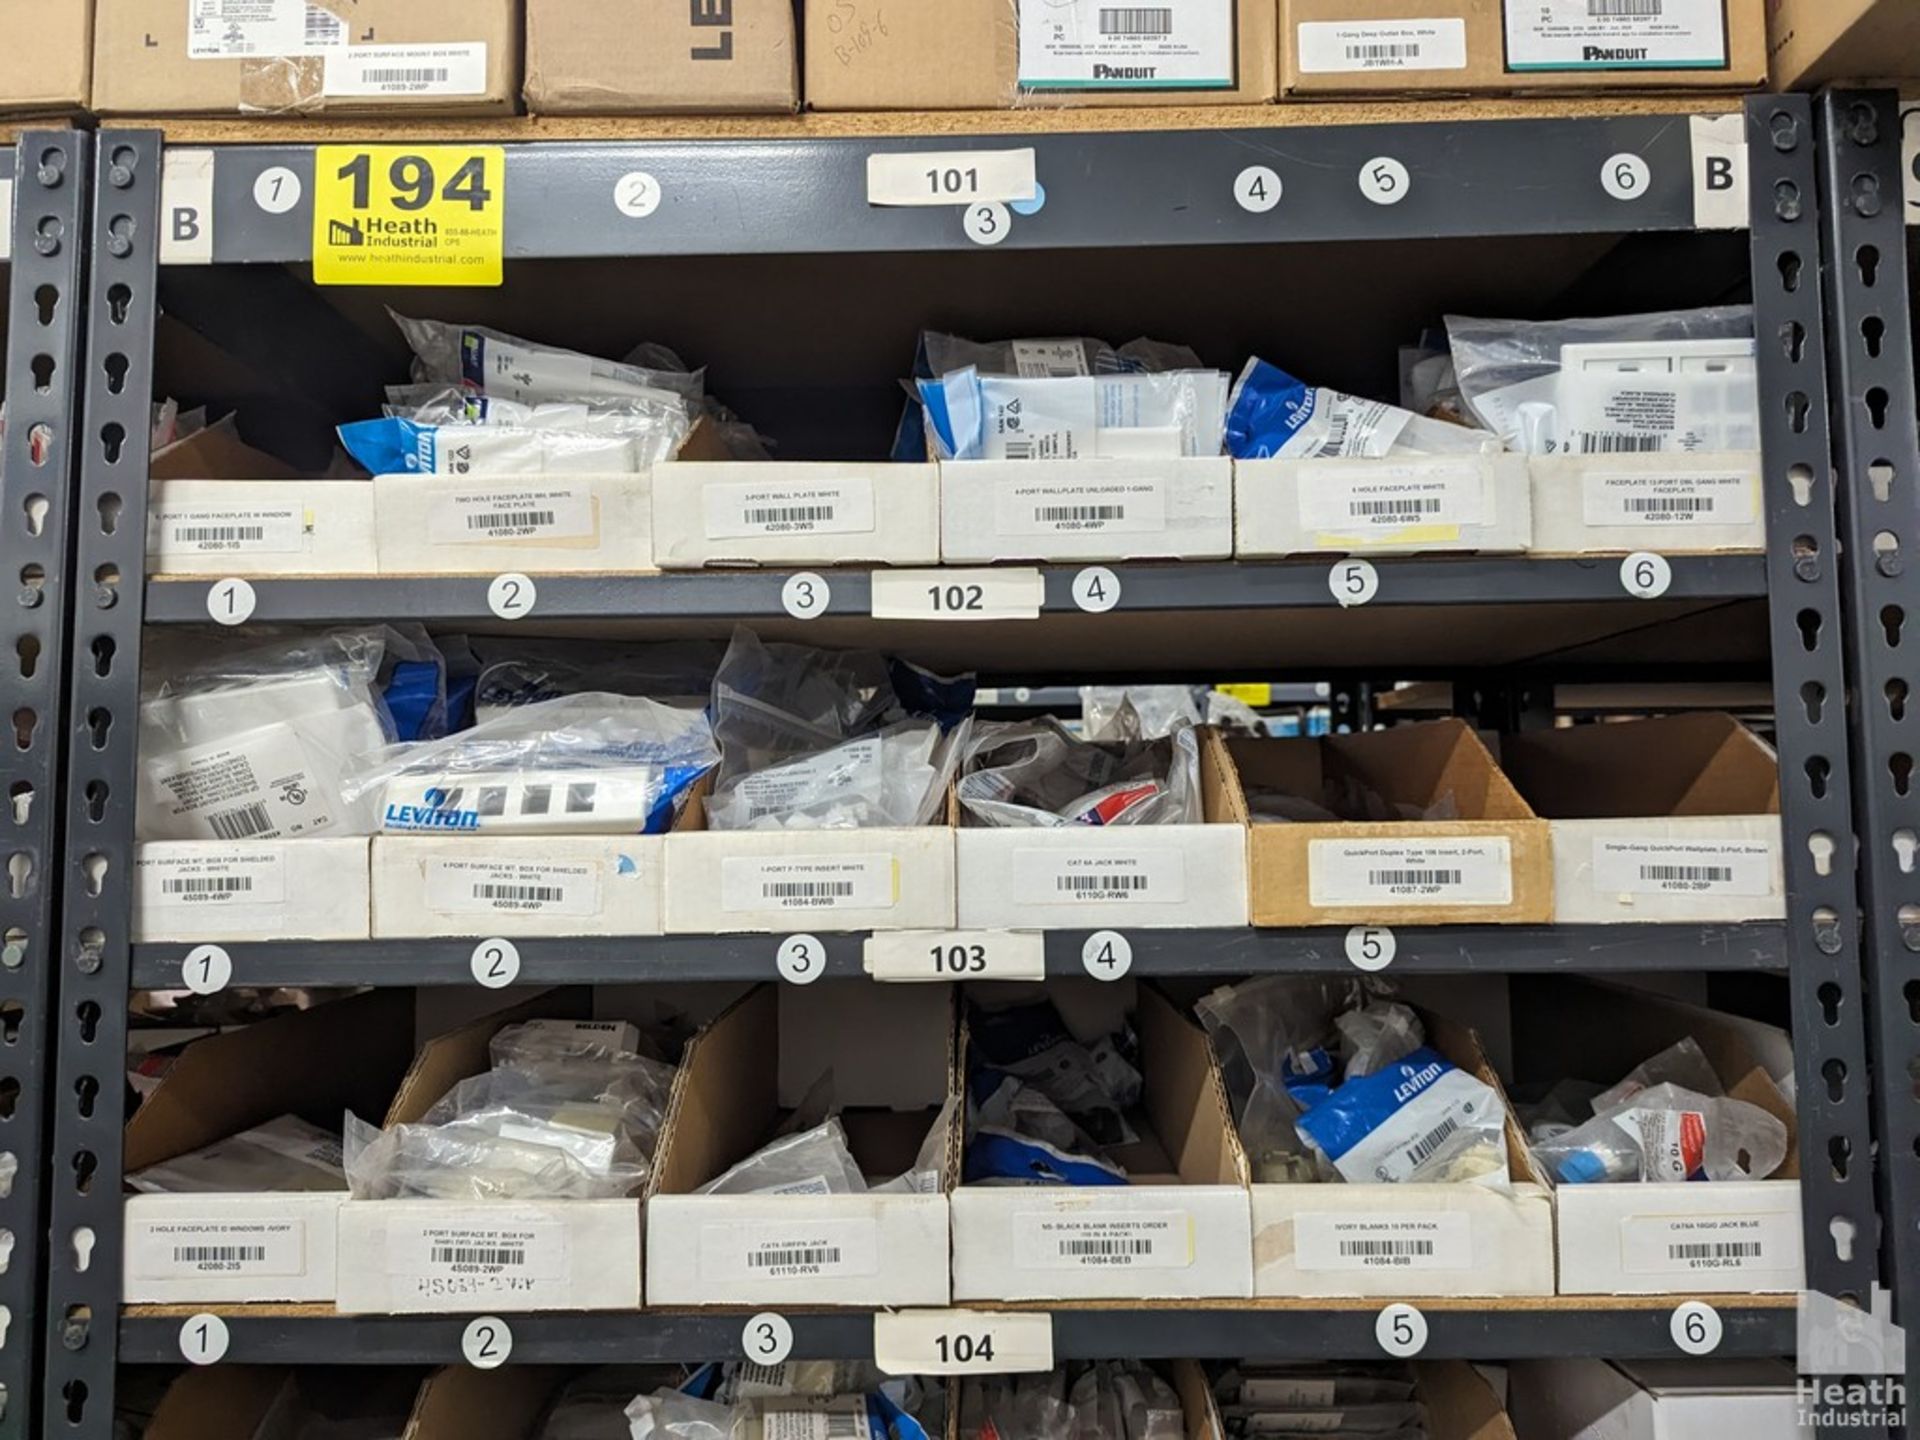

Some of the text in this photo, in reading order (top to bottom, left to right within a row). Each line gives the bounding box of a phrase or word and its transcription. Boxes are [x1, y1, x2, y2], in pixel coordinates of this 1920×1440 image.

[374, 51, 404, 59] SURFACE
[406, 50, 431, 58] MOUNT
[448, 49, 470, 57] WHITE
[1583, 46, 1648, 60] PANDUIT
[1093, 63, 1157, 79] PANDUIT
[337, 154, 491, 211] 194
[926, 168, 979, 193] 101
[1371, 164, 1396, 192] 5
[1615, 164, 1635, 189] 6
[1706, 157, 1733, 190] B
[268, 175, 284, 201] 1
[628, 181, 646, 207] 2
[1247, 175, 1268, 201] 4
[173, 208, 199, 241] B
[367, 217, 437, 234] Heath
[977, 208, 996, 234] 3
[367, 236, 437, 248] Industrial
[455, 491, 572, 504] TWO HOLE FACEPLATE WHITE
[772, 492, 793, 500] WALL
[793, 491, 816, 499] PLATE
[818, 490, 840, 498] WHITE
[1042, 487, 1084, 495] WALLPLATE
[1085, 486, 1125, 494] UNLOADED
[1379, 484, 1421, 492] FACEPLATE
[488, 527, 537, 537] 41080-2WP
[1345, 566, 1366, 594] 5
[1635, 561, 1654, 586] 6
[224, 586, 237, 614] 1
[501, 581, 520, 607] 2
[796, 582, 814, 607] 3
[927, 587, 984, 610] 102
[1086, 577, 1105, 603] 4
[386, 804, 480, 827] LEVITON
[239, 855, 275, 863] SHIELDED
[1344, 849, 1379, 857] QuickPort
[1380, 849, 1404, 857] Duplex
[1405, 849, 1423, 857] Type
[1605, 844, 1649, 852] Single-Gang
[1650, 844, 1684, 852] QuickPort
[470, 863, 502, 871] SURFACE
[552, 867, 587, 875] SHIELDED
[1097, 941, 1116, 969] 4
[1362, 931, 1381, 959] 5
[198, 956, 212, 984] 1
[485, 950, 506, 978] 2
[791, 946, 811, 972] 3
[930, 946, 986, 972] 103
[575, 1022, 616, 1032] BELDEN
[1393, 1062, 1443, 1102] LEVITON
[1719, 1221, 1738, 1229] JACK
[1740, 1220, 1760, 1228] BLUE
[195, 1324, 210, 1353] 1
[757, 1323, 777, 1354] 3
[1394, 1314, 1413, 1345] 5
[1684, 1313, 1705, 1343] 6
[478, 1327, 497, 1357] 2
[935, 1334, 995, 1363] 104
